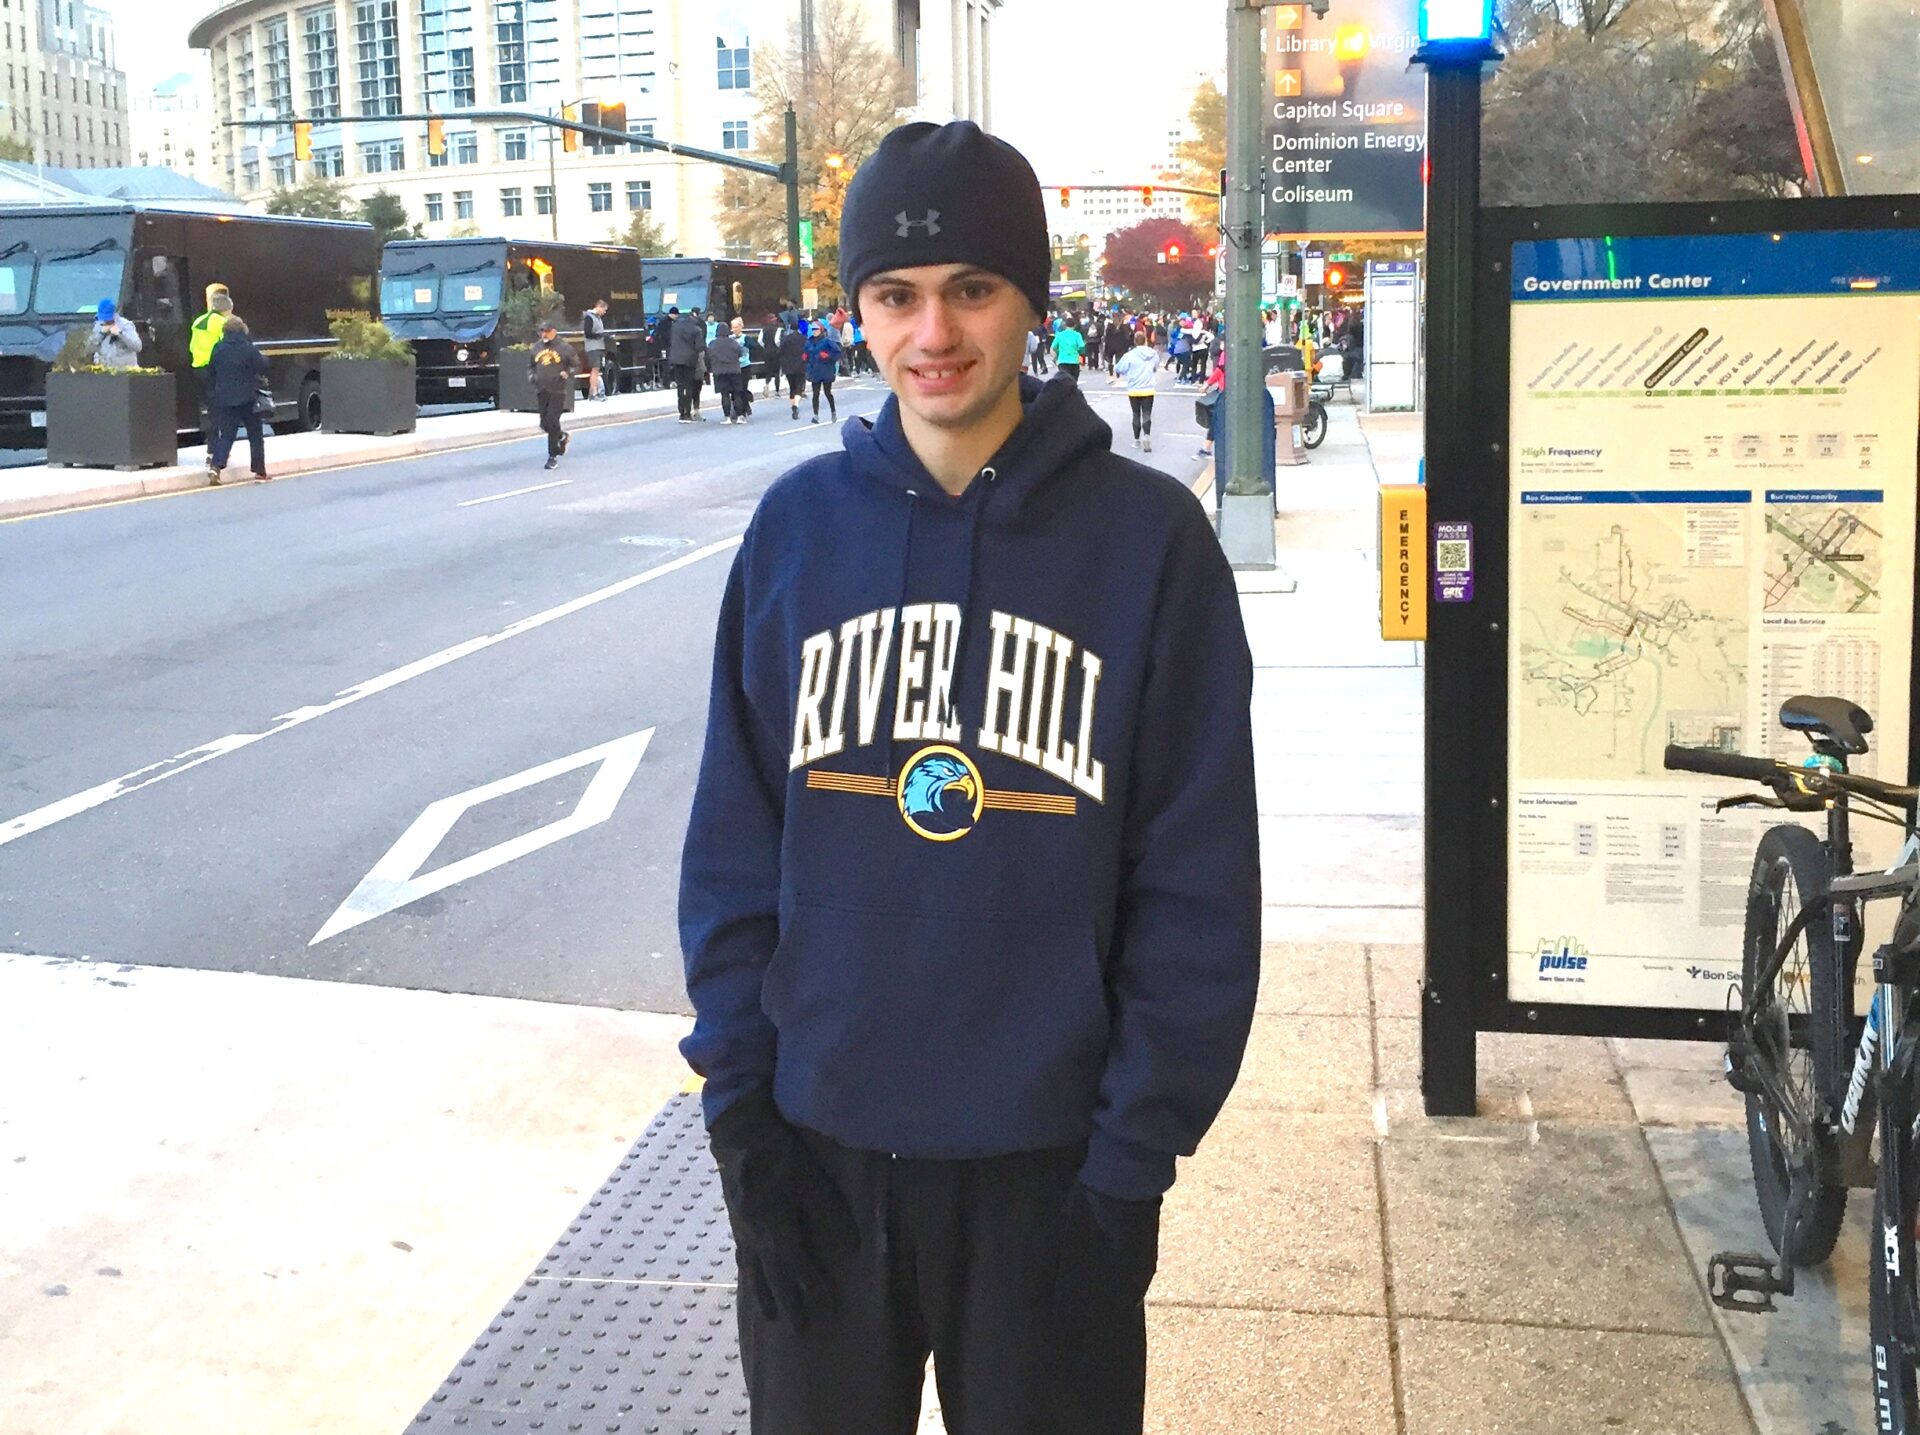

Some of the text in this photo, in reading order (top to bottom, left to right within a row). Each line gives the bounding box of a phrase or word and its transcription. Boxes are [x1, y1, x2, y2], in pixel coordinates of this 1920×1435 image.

[1276, 35, 1337, 55] Library
[1369, 31, 1420, 51] Virgin
[1273, 100, 1404, 122] Capitol Square
[1272, 132, 1425, 152] Dominion Energy
[1272, 157, 1333, 173] Center
[1272, 186, 1353, 203] Coliseum
[1523, 274, 1712, 292] Government Center
[1521, 446, 1602, 458] High Frequency
[1810, 492, 1838, 502] nearby
[1399, 509, 1409, 625] EMERGENCY
[789, 602, 1105, 805] RIVER HILL
[1538, 946, 1588, 973] pulse
[1702, 970, 1725, 980] Bon
